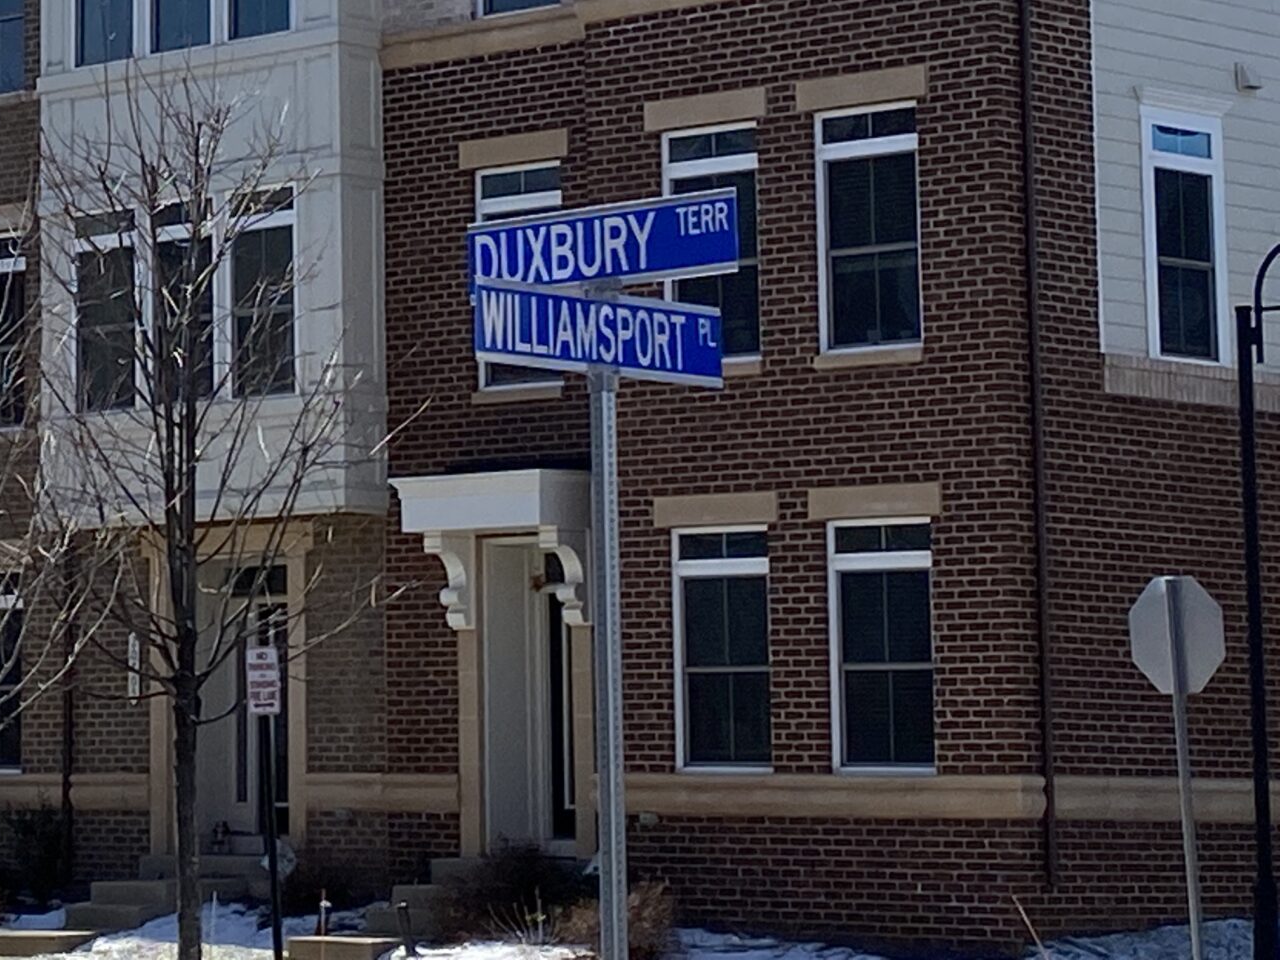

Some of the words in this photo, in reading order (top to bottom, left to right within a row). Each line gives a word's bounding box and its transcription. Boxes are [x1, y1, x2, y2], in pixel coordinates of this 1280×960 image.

[474, 211, 656, 284] DUXBURY
[676, 202, 729, 237] TERR
[481, 290, 686, 371] WILLIAMSPORT
[698, 318, 718, 348] PL
